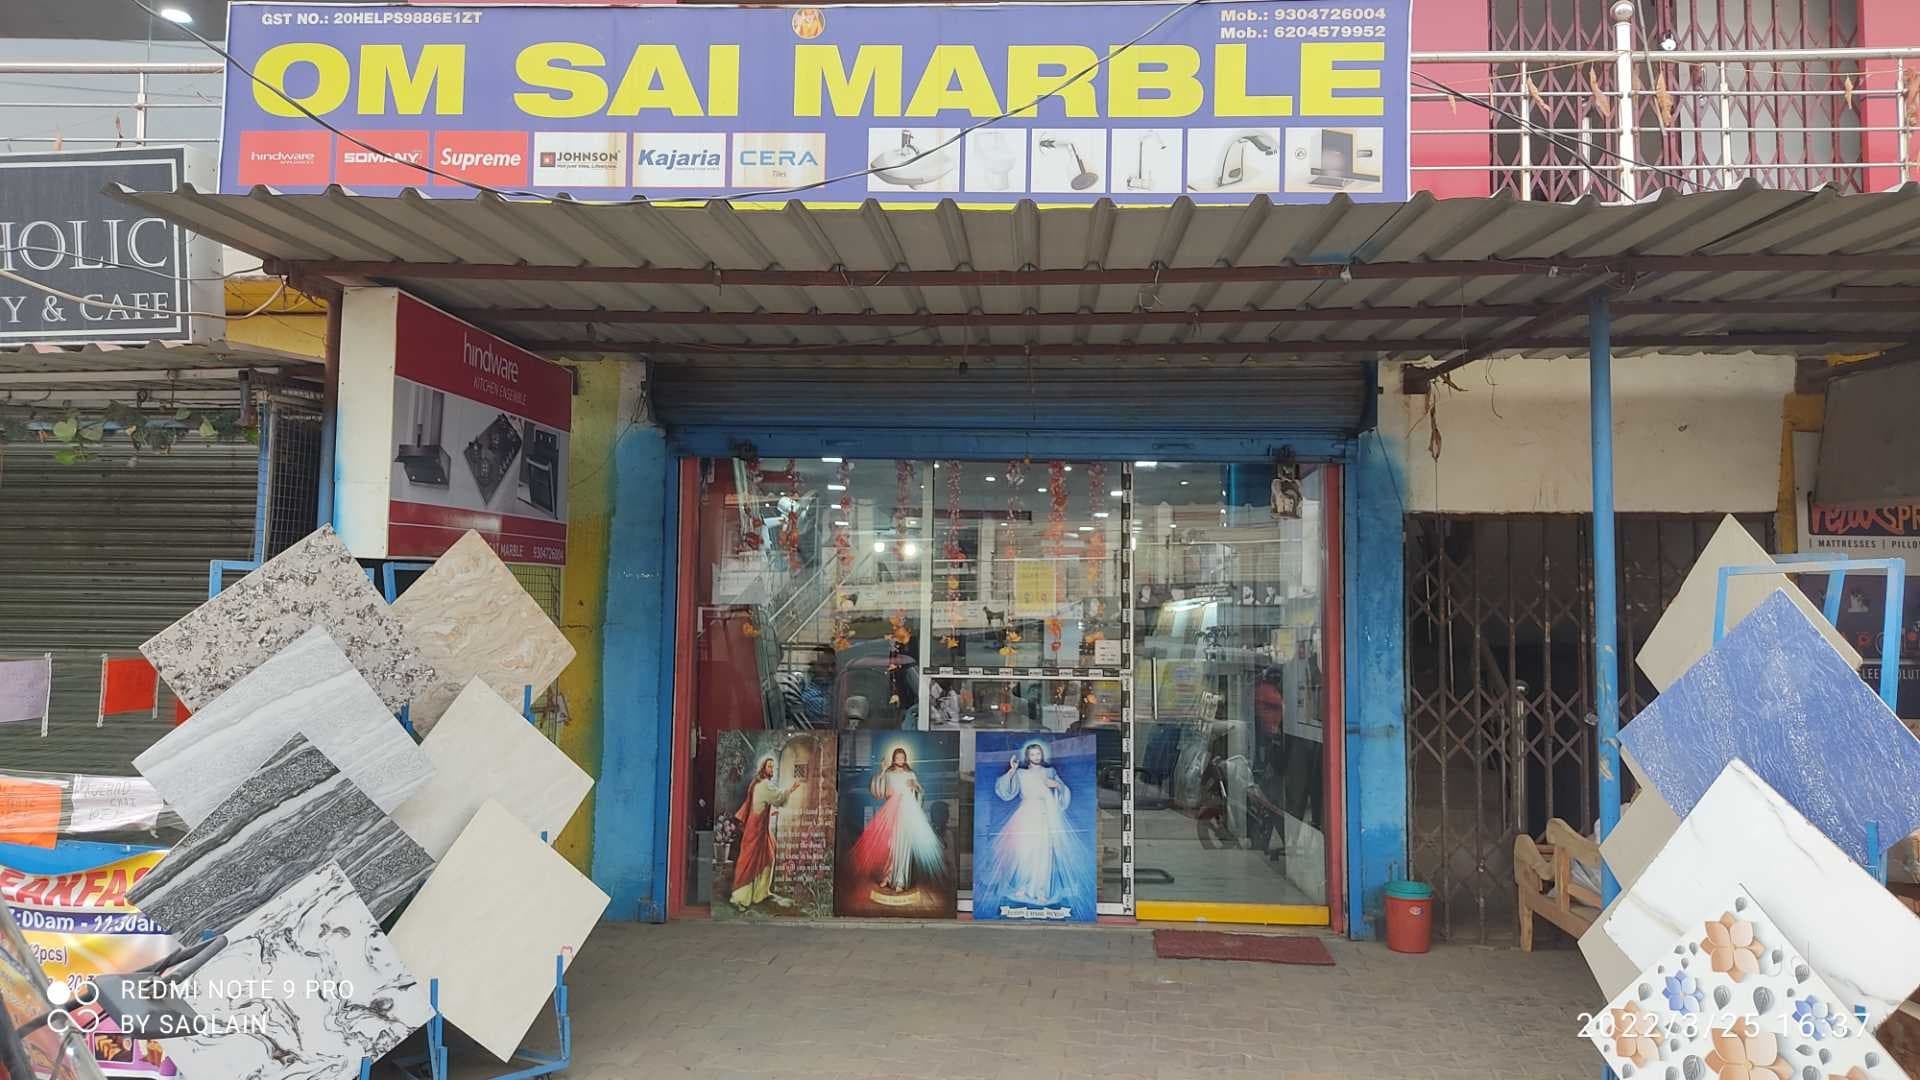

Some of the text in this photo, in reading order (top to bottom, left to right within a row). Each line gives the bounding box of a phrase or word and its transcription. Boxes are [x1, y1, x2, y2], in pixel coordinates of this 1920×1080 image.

[262, 13, 292, 25] GST
[297, 13, 329, 25] NO.:
[1221, 8, 1386, 21] Mob.: 9304726004
[1221, 26, 1386, 39] Mob.: 6204579952
[252, 42, 1385, 118] OM SAI MARBLE
[251, 151, 315, 162] hindware
[343, 152, 419, 163] SOMANY
[440, 148, 521, 171] Supreme
[556, 152, 618, 162] JOHNSON
[638, 149, 720, 170] Kajaria
[740, 150, 818, 166] CERA
[42, 295, 66, 323] &
[79, 292, 169, 321] CAFE
[463, 330, 519, 383] hindware
[1818, 539, 1920, 549] MATTRESSES PILLO
